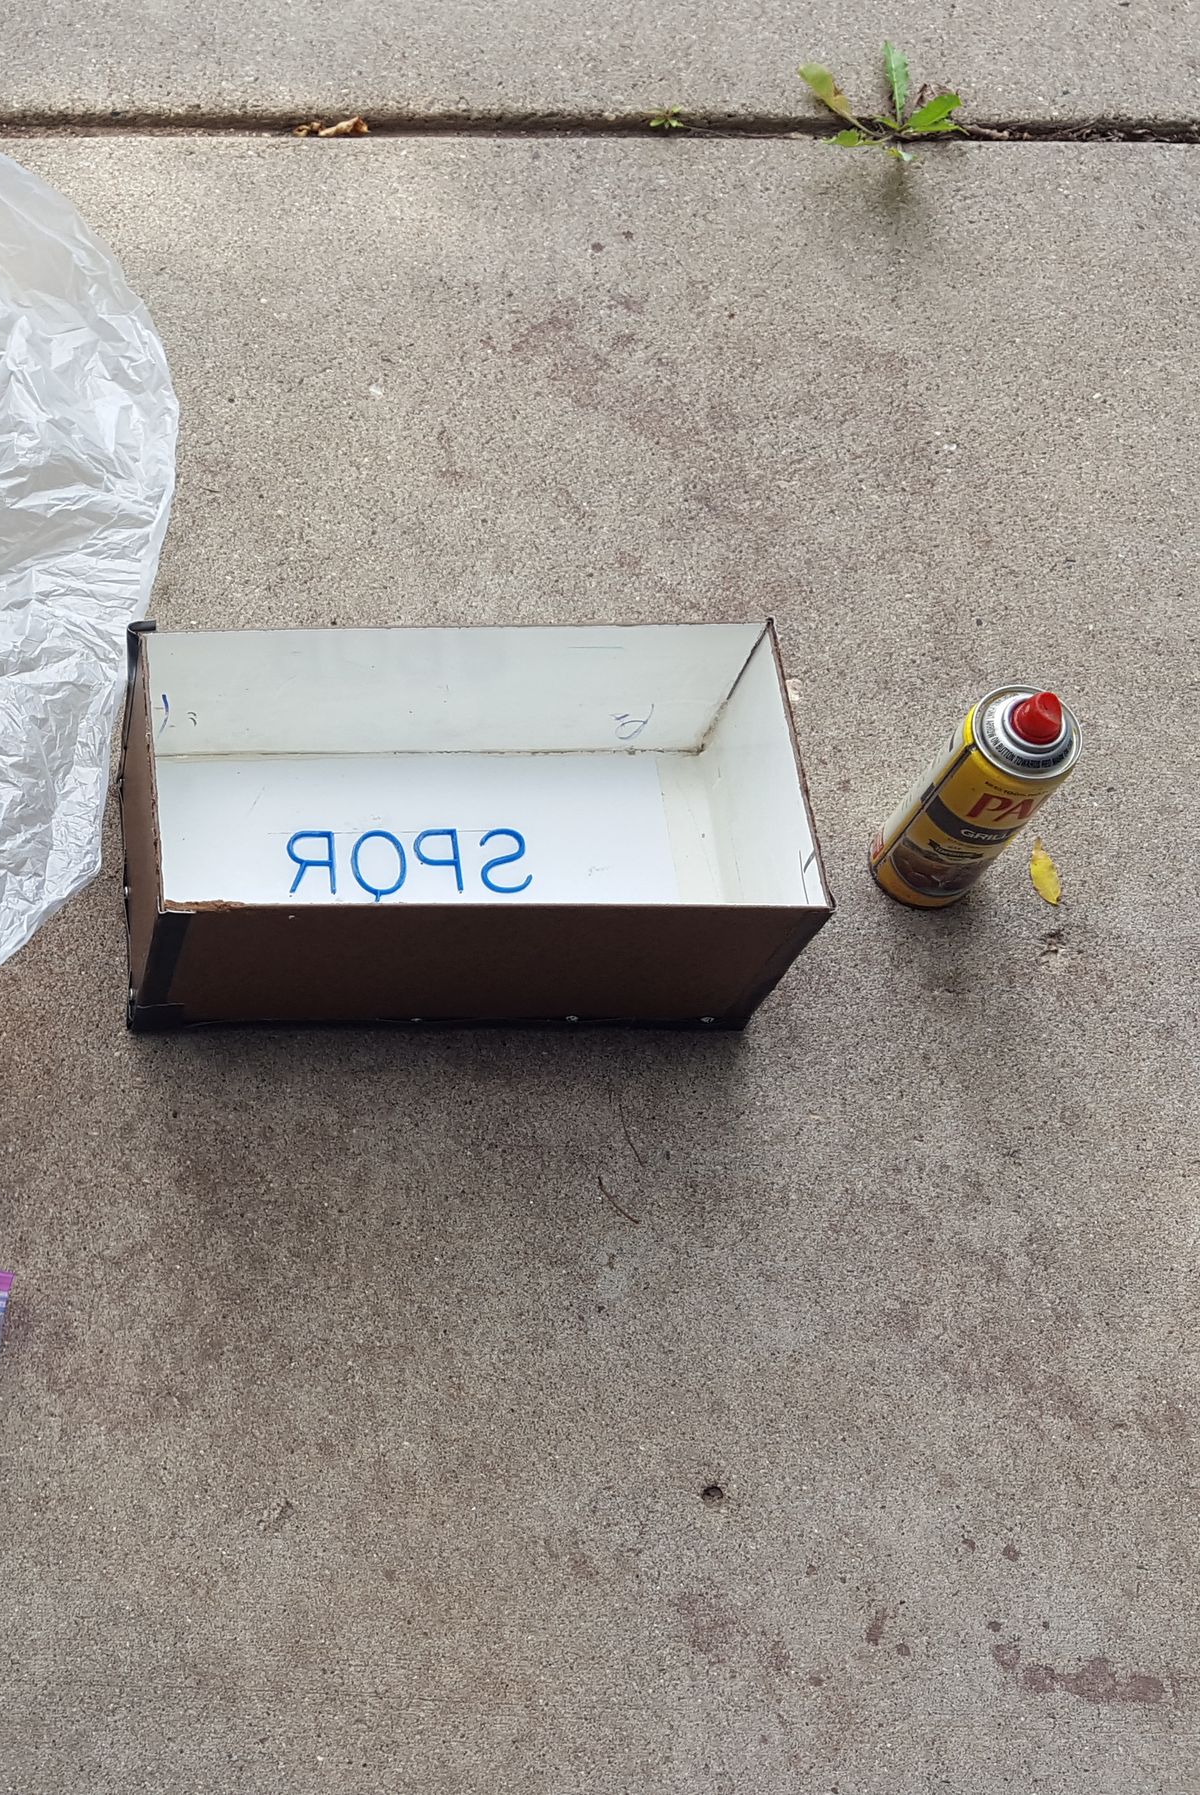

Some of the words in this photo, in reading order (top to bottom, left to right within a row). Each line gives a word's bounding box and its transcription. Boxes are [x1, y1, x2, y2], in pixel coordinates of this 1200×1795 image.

[995, 743, 1016, 763] BUTTON
[1013, 753, 1041, 769] TOWARDS
[966, 790, 1046, 823] PA
